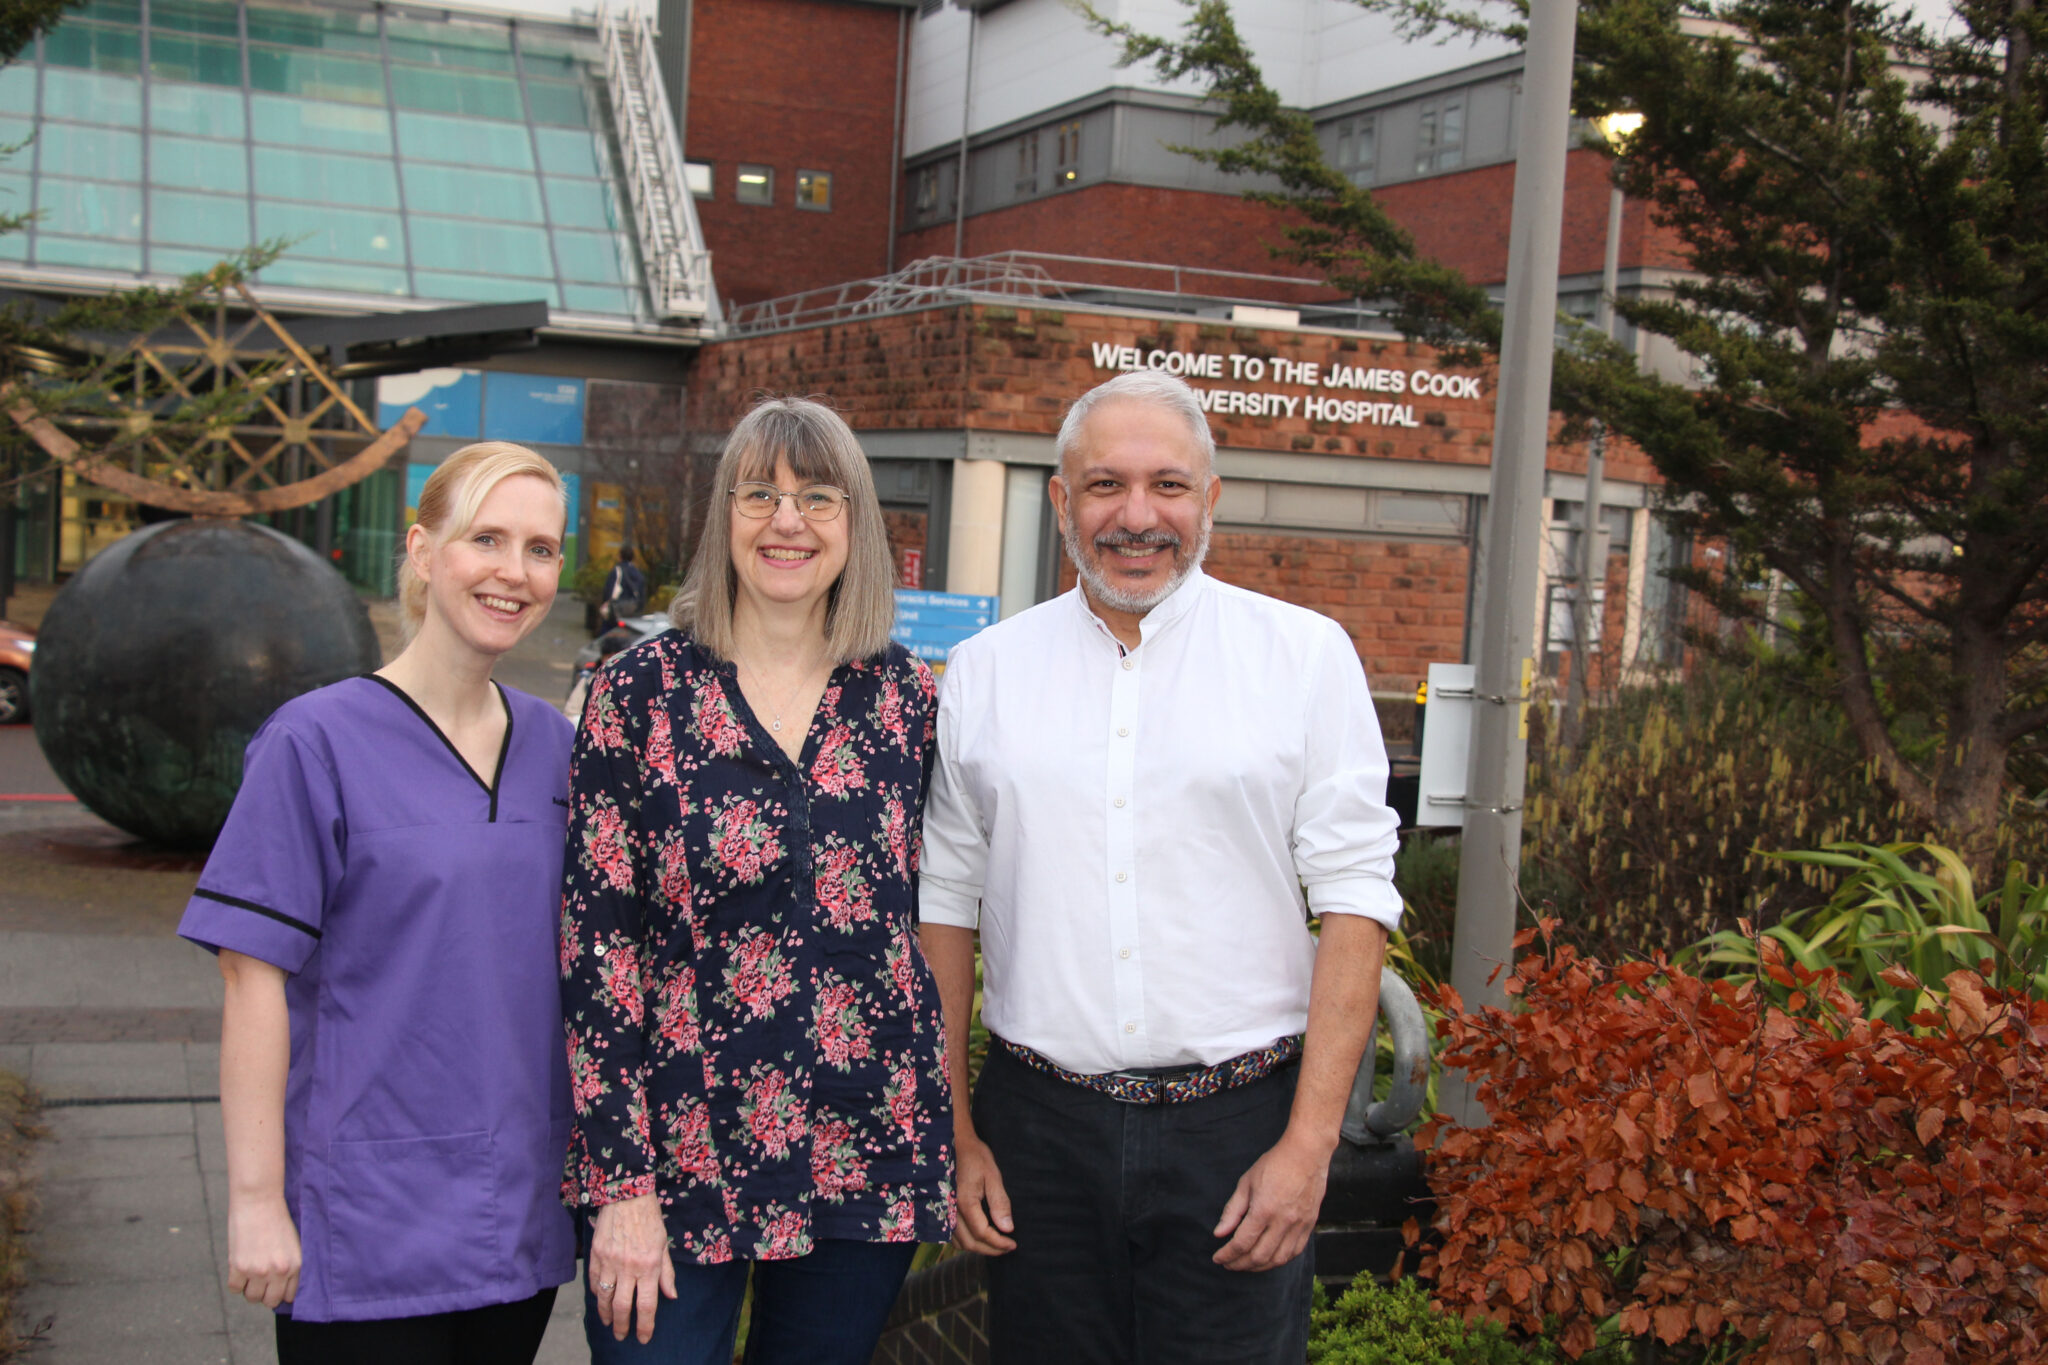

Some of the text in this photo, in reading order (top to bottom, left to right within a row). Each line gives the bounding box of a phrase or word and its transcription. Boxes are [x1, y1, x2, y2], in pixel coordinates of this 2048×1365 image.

[1092, 341, 1481, 399] WELCOME TO THE JAMES COOK
[1304, 395, 1420, 428] HOSPITAL
[928, 594, 969, 608] Services
